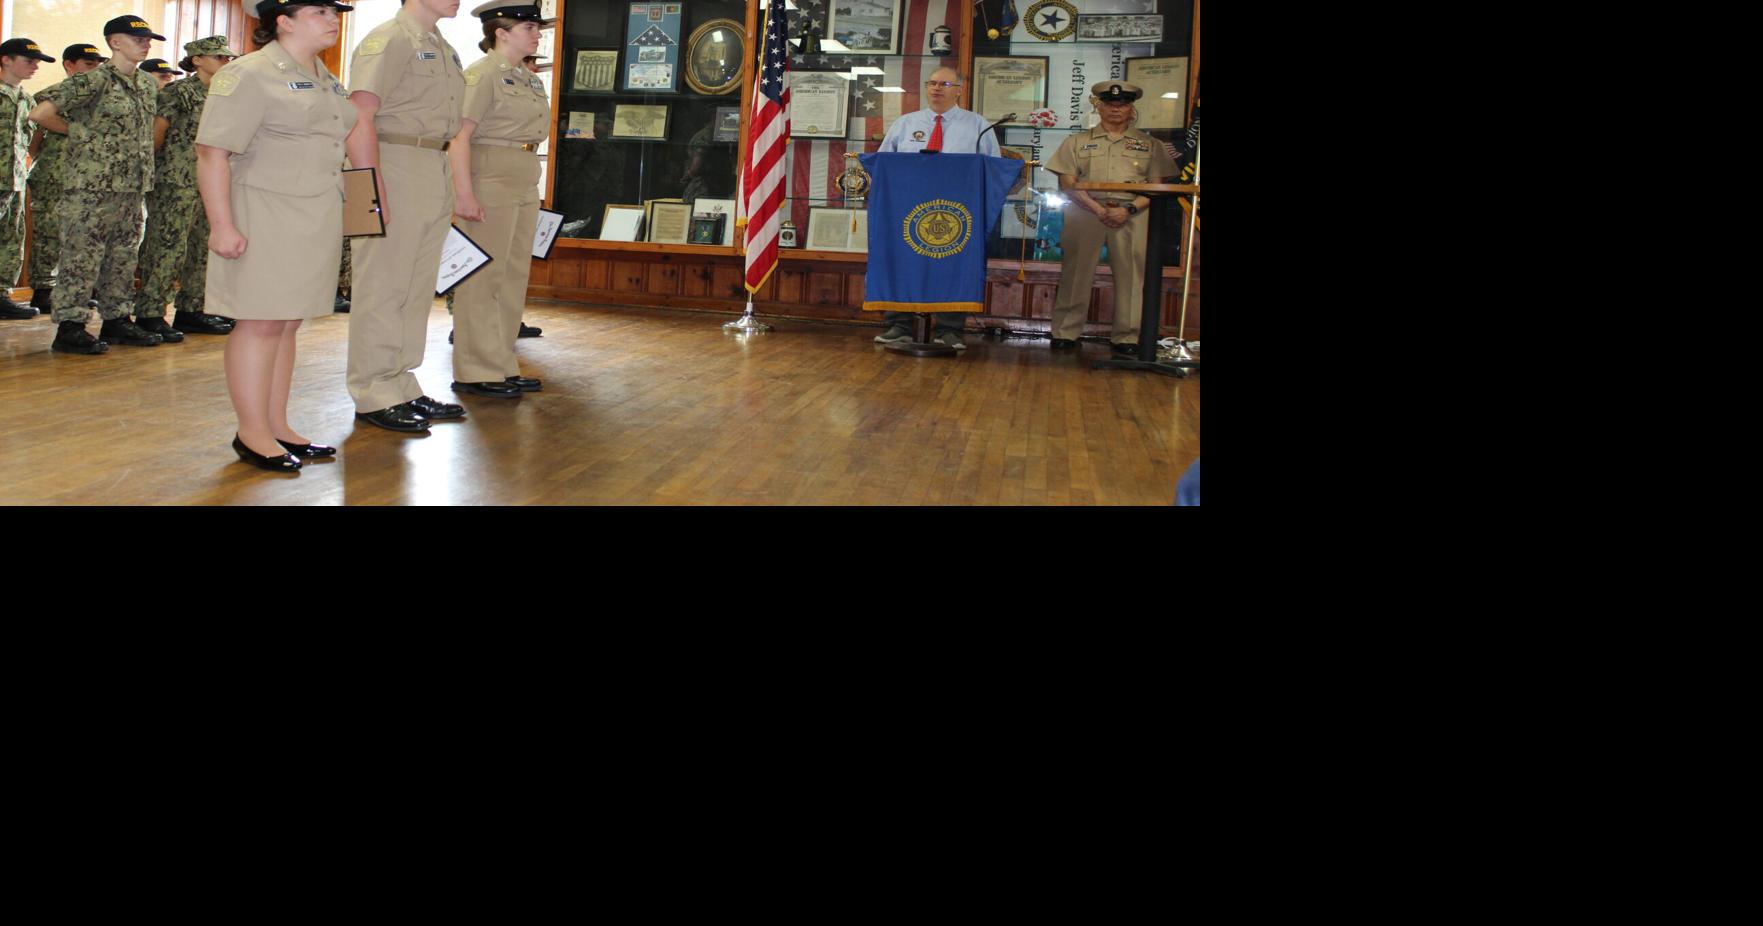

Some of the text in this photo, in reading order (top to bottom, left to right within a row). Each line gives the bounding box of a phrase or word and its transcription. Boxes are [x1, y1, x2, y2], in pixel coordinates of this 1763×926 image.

[1072, 59, 1085, 85] Jeff
[1070, 86, 1084, 121] Davis
[913, 205, 966, 223] AMERICAN
[933, 224, 946, 233] US
[919, 241, 960, 253] LEGION
